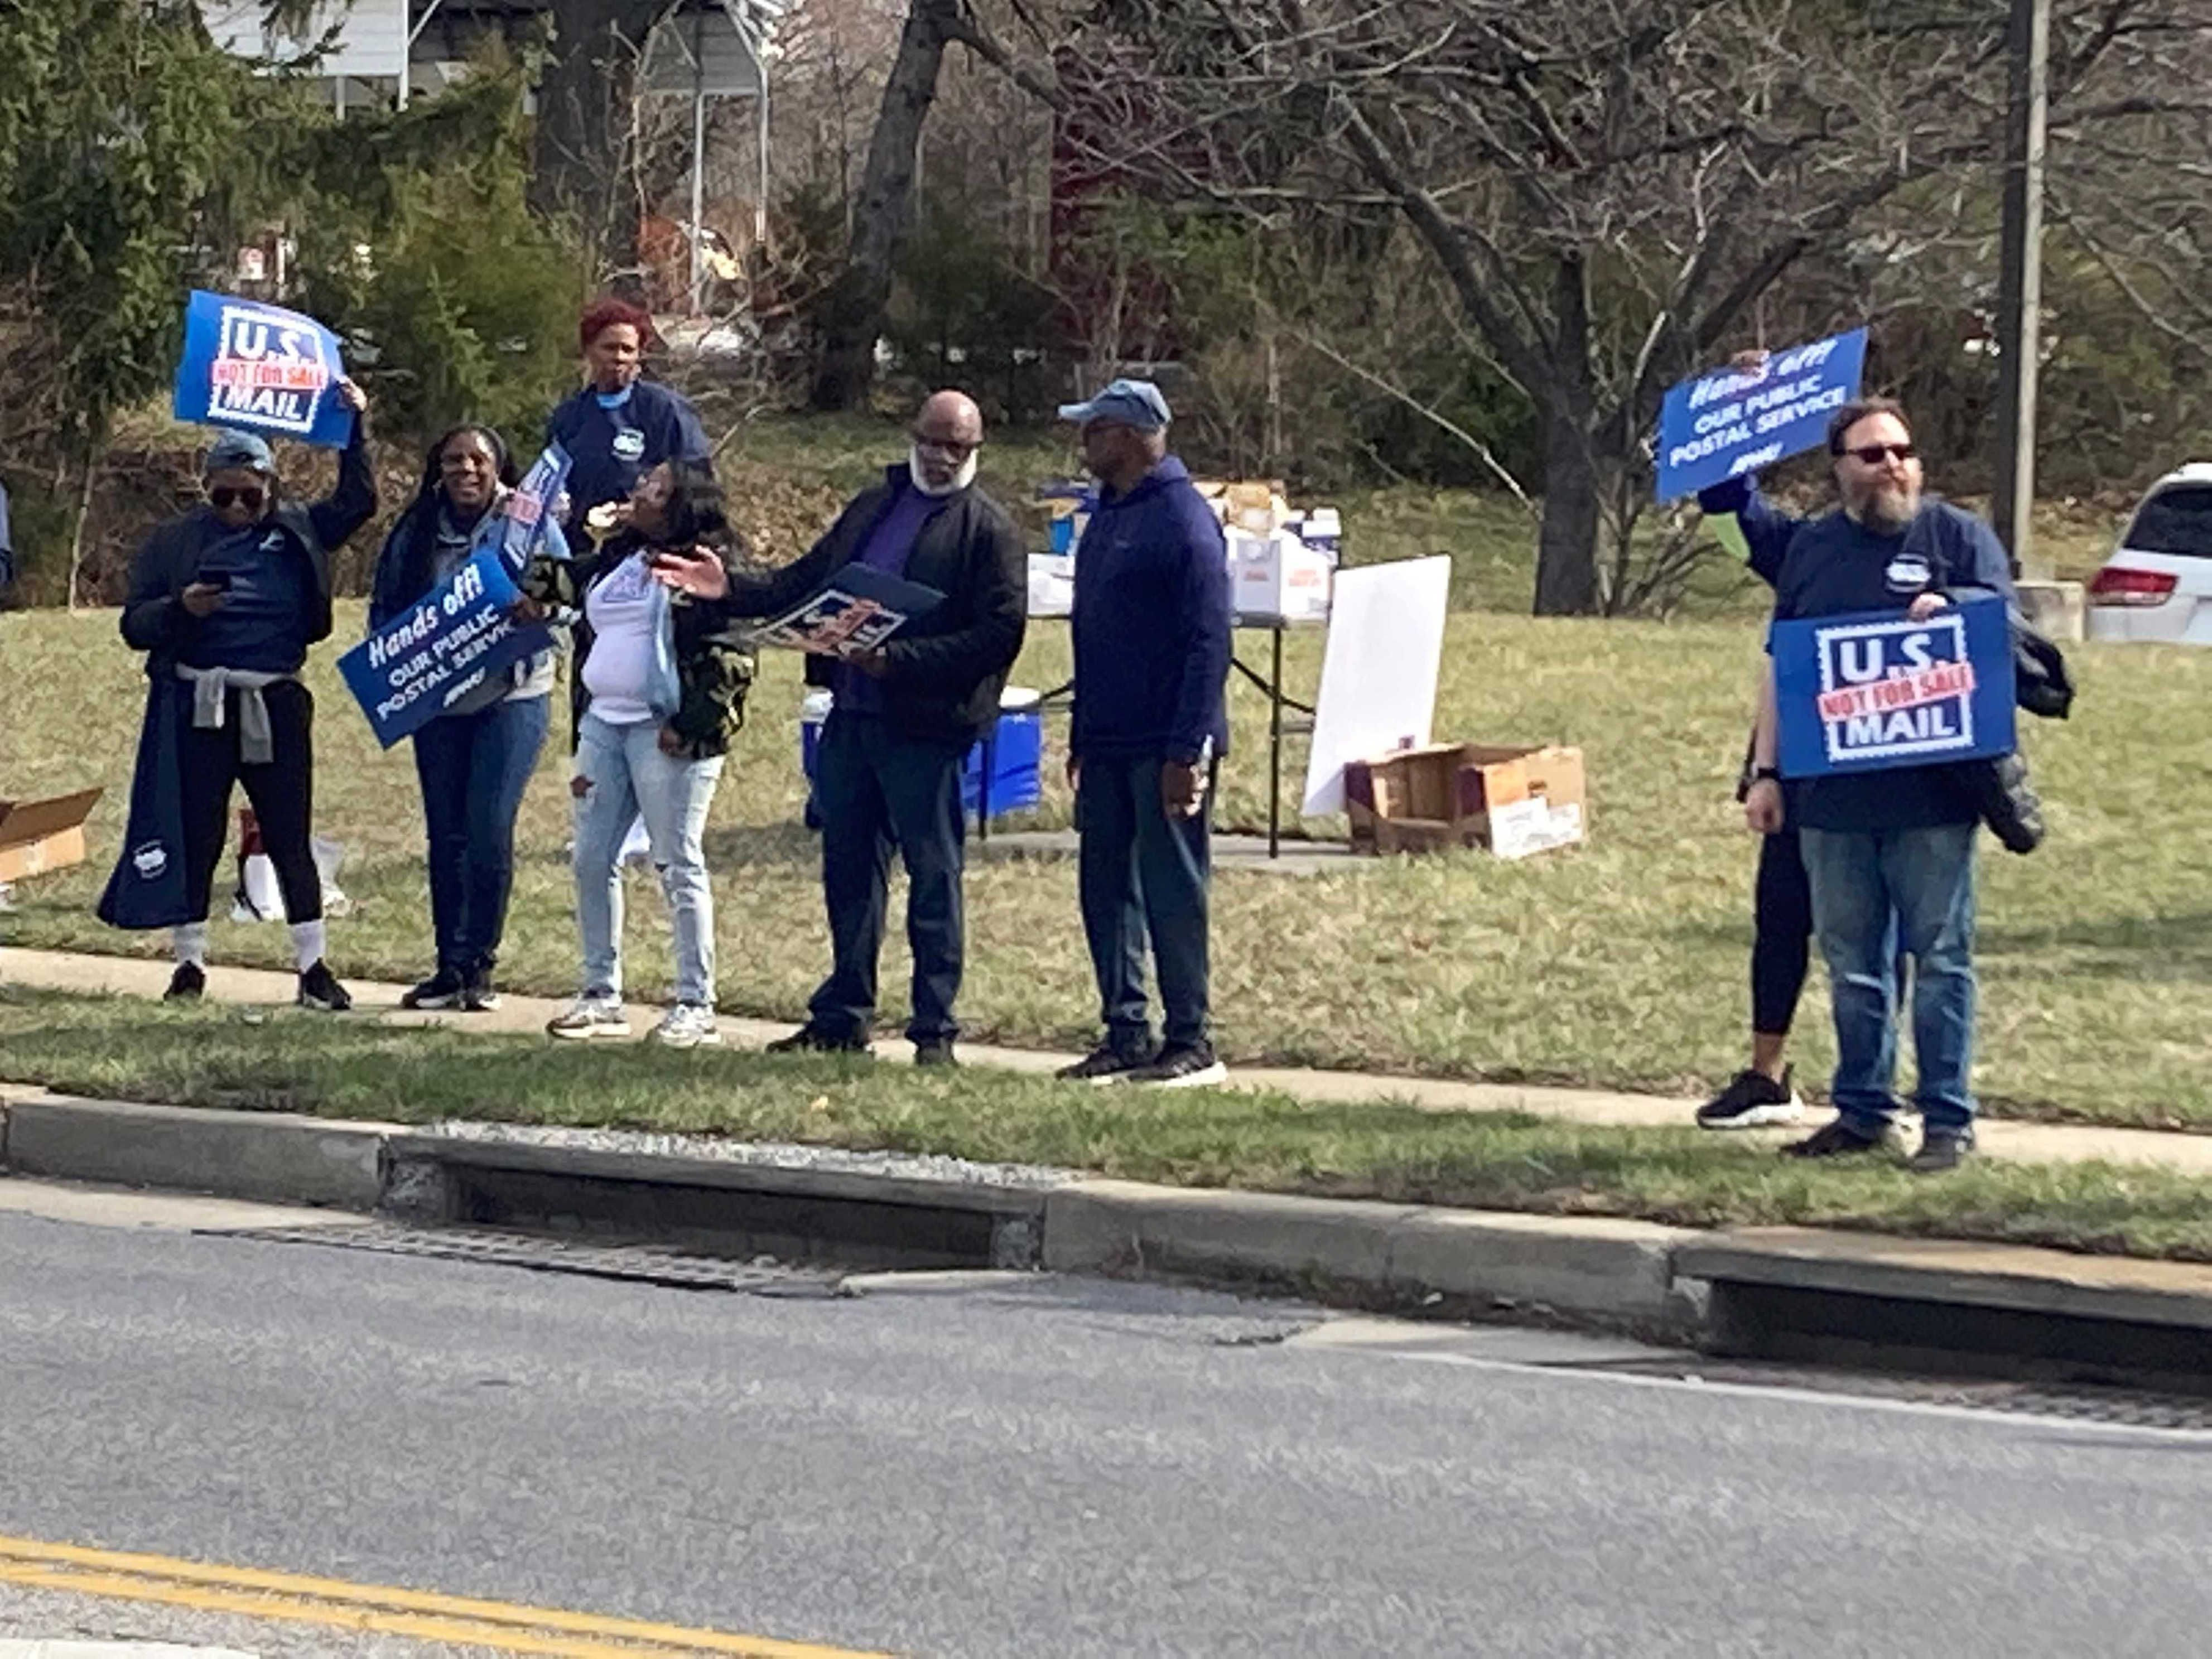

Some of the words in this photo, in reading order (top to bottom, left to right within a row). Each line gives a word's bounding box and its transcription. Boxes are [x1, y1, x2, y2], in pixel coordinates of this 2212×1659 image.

[234, 321, 317, 364] U.S.
[225, 385, 302, 419] MAIL
[287, 366, 324, 387] SALE
[1670, 421, 1753, 468] POSTAL
[1755, 385, 1847, 434] SERVICE
[1694, 402, 1742, 435] OUR
[1746, 374, 1823, 415] PUBLIC
[368, 605, 439, 669] Hands
[389, 651, 433, 687] OUR
[432, 602, 500, 659] PUBLIC
[1839, 633, 1951, 683] U.S.
[376, 664, 452, 722] POSTAL
[1823, 692, 1866, 717] NOT
[1873, 681, 1915, 707] FOR
[1922, 665, 1969, 697] SALE
[1845, 706, 1956, 746] MAIL
